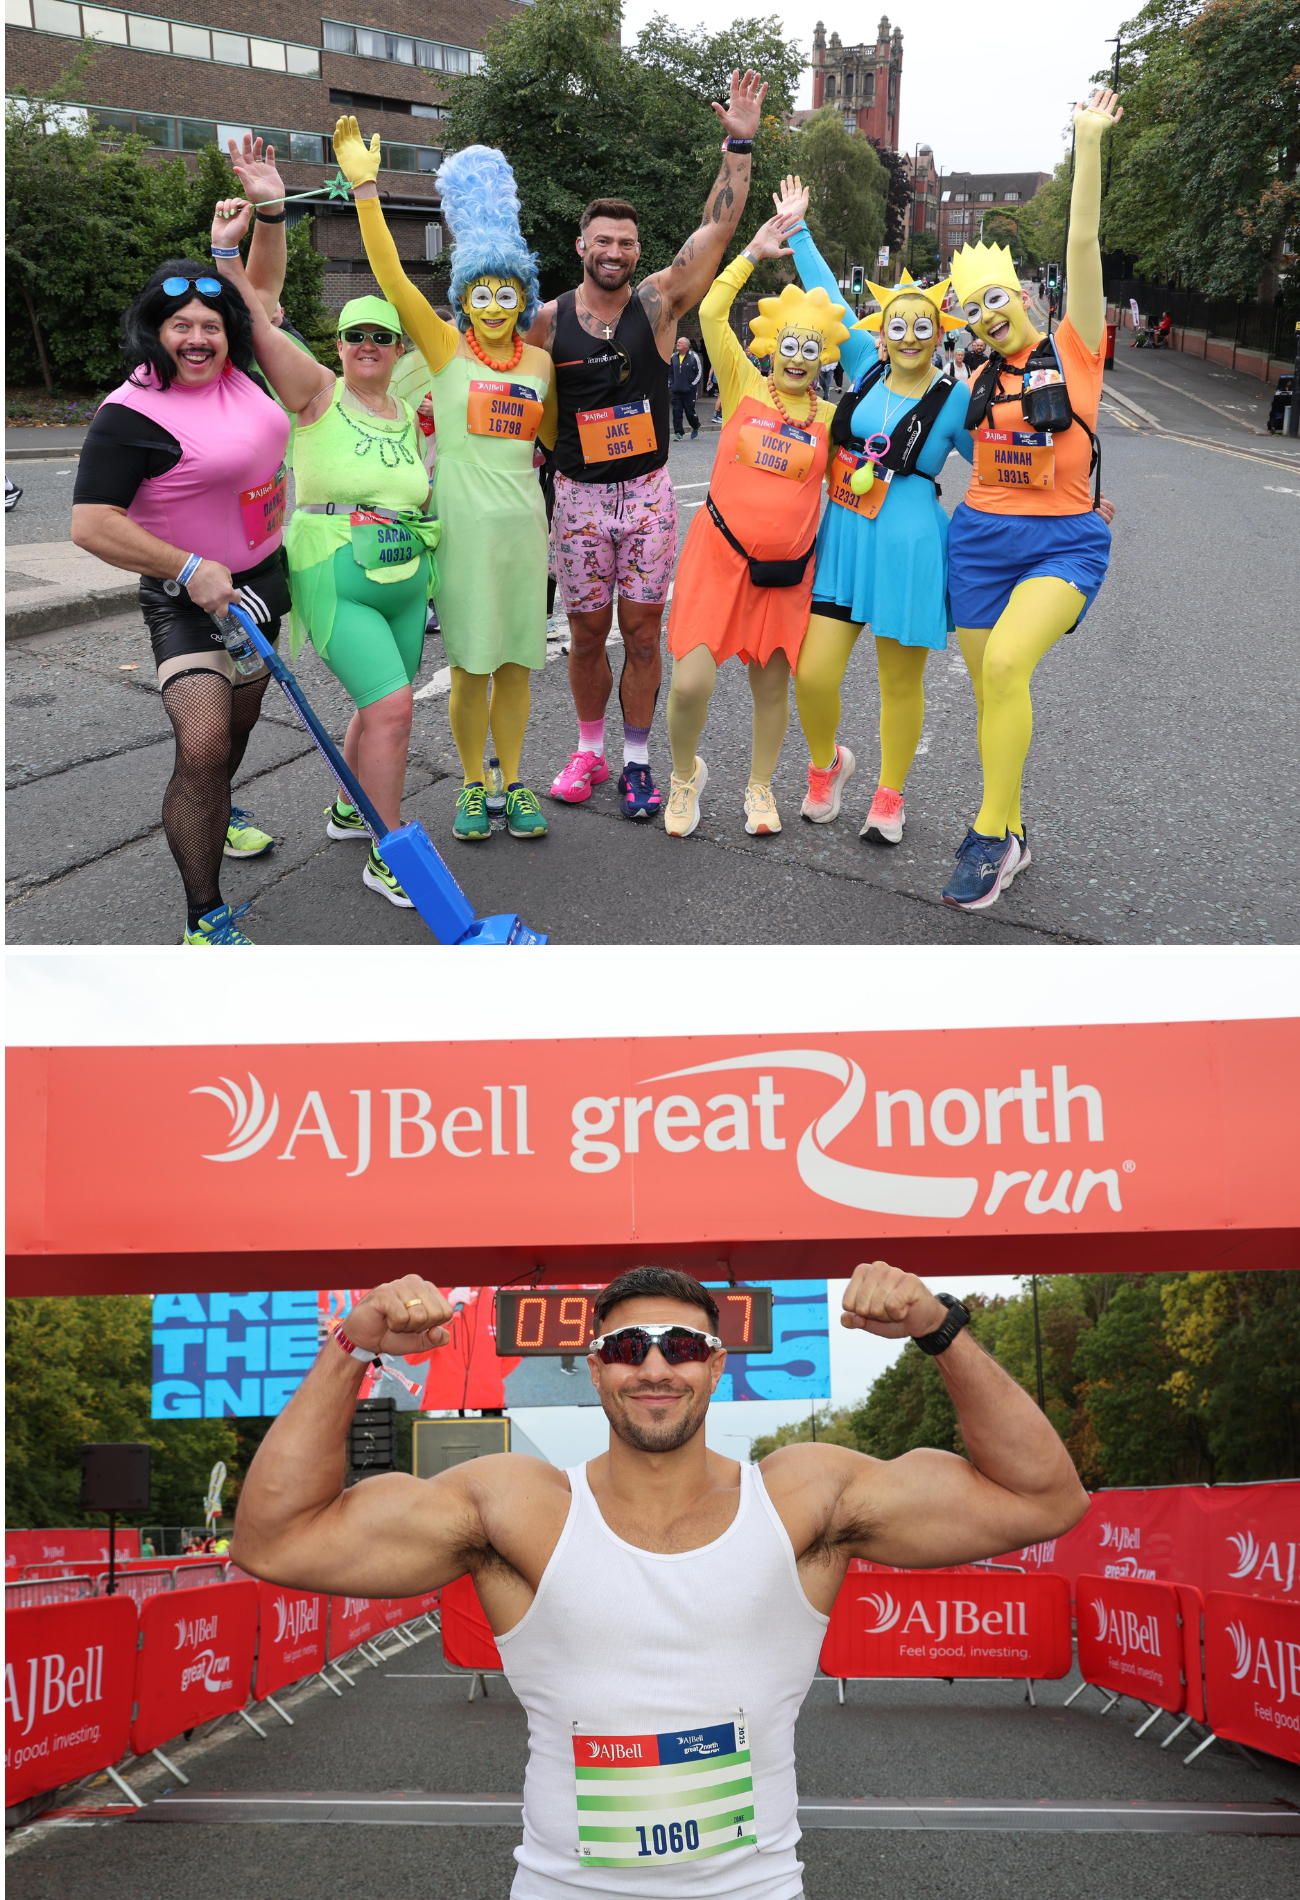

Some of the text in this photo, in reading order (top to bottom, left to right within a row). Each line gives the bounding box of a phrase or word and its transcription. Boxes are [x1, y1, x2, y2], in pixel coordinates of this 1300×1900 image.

[483, 384, 504, 392] AJBell
[491, 400, 524, 416] SIMON
[590, 412, 608, 420] AJBell
[489, 418, 522, 435] 16798
[606, 422, 630, 439] JAKE
[755, 420, 776, 428] AJBell
[762, 434, 792, 454] VICKY
[990, 432, 1007, 440] AJBell
[607, 440, 634, 456] 5954
[754, 451, 788, 472] 10058
[994, 450, 1032, 466] HANNAH
[998, 469, 1030, 484] 19315
[834, 486, 860, 508] 12331
[378, 529, 412, 544] SARAH
[380, 547, 412, 563] 40313
[278, 1066, 1104, 1176] AJBell great north
[984, 1167, 1122, 1215] run
[154, 1292, 318, 1325] ARE
[152, 1326, 318, 1376] THE
[1111, 1527, 1141, 1552] AJBell
[285, 1597, 319, 1645] AJBell
[900, 1601, 1029, 1642] AJBell
[184, 1615, 218, 1650] AJBell
[1108, 1608, 1162, 1657] AJBell
[900, 1645, 1031, 1660] Feel good, investing.
[181, 1656, 230, 1692] great run
[1108, 1656, 1120, 1670] Feel
[1120, 1659, 1137, 1676] good,
[220, 1678, 233, 1690] series
[1254, 1702, 1273, 1722] Feel
[683, 1734, 704, 1744] AJBell
[738, 1727, 746, 1744] 2025
[14, 1724, 102, 1770] good, investing.
[600, 1744, 643, 1762] AJBell
[684, 1742, 718, 1754] great north
[733, 1814, 745, 1824] ZONE
[636, 1820, 700, 1856] 1060
[737, 1826, 743, 1838] A
